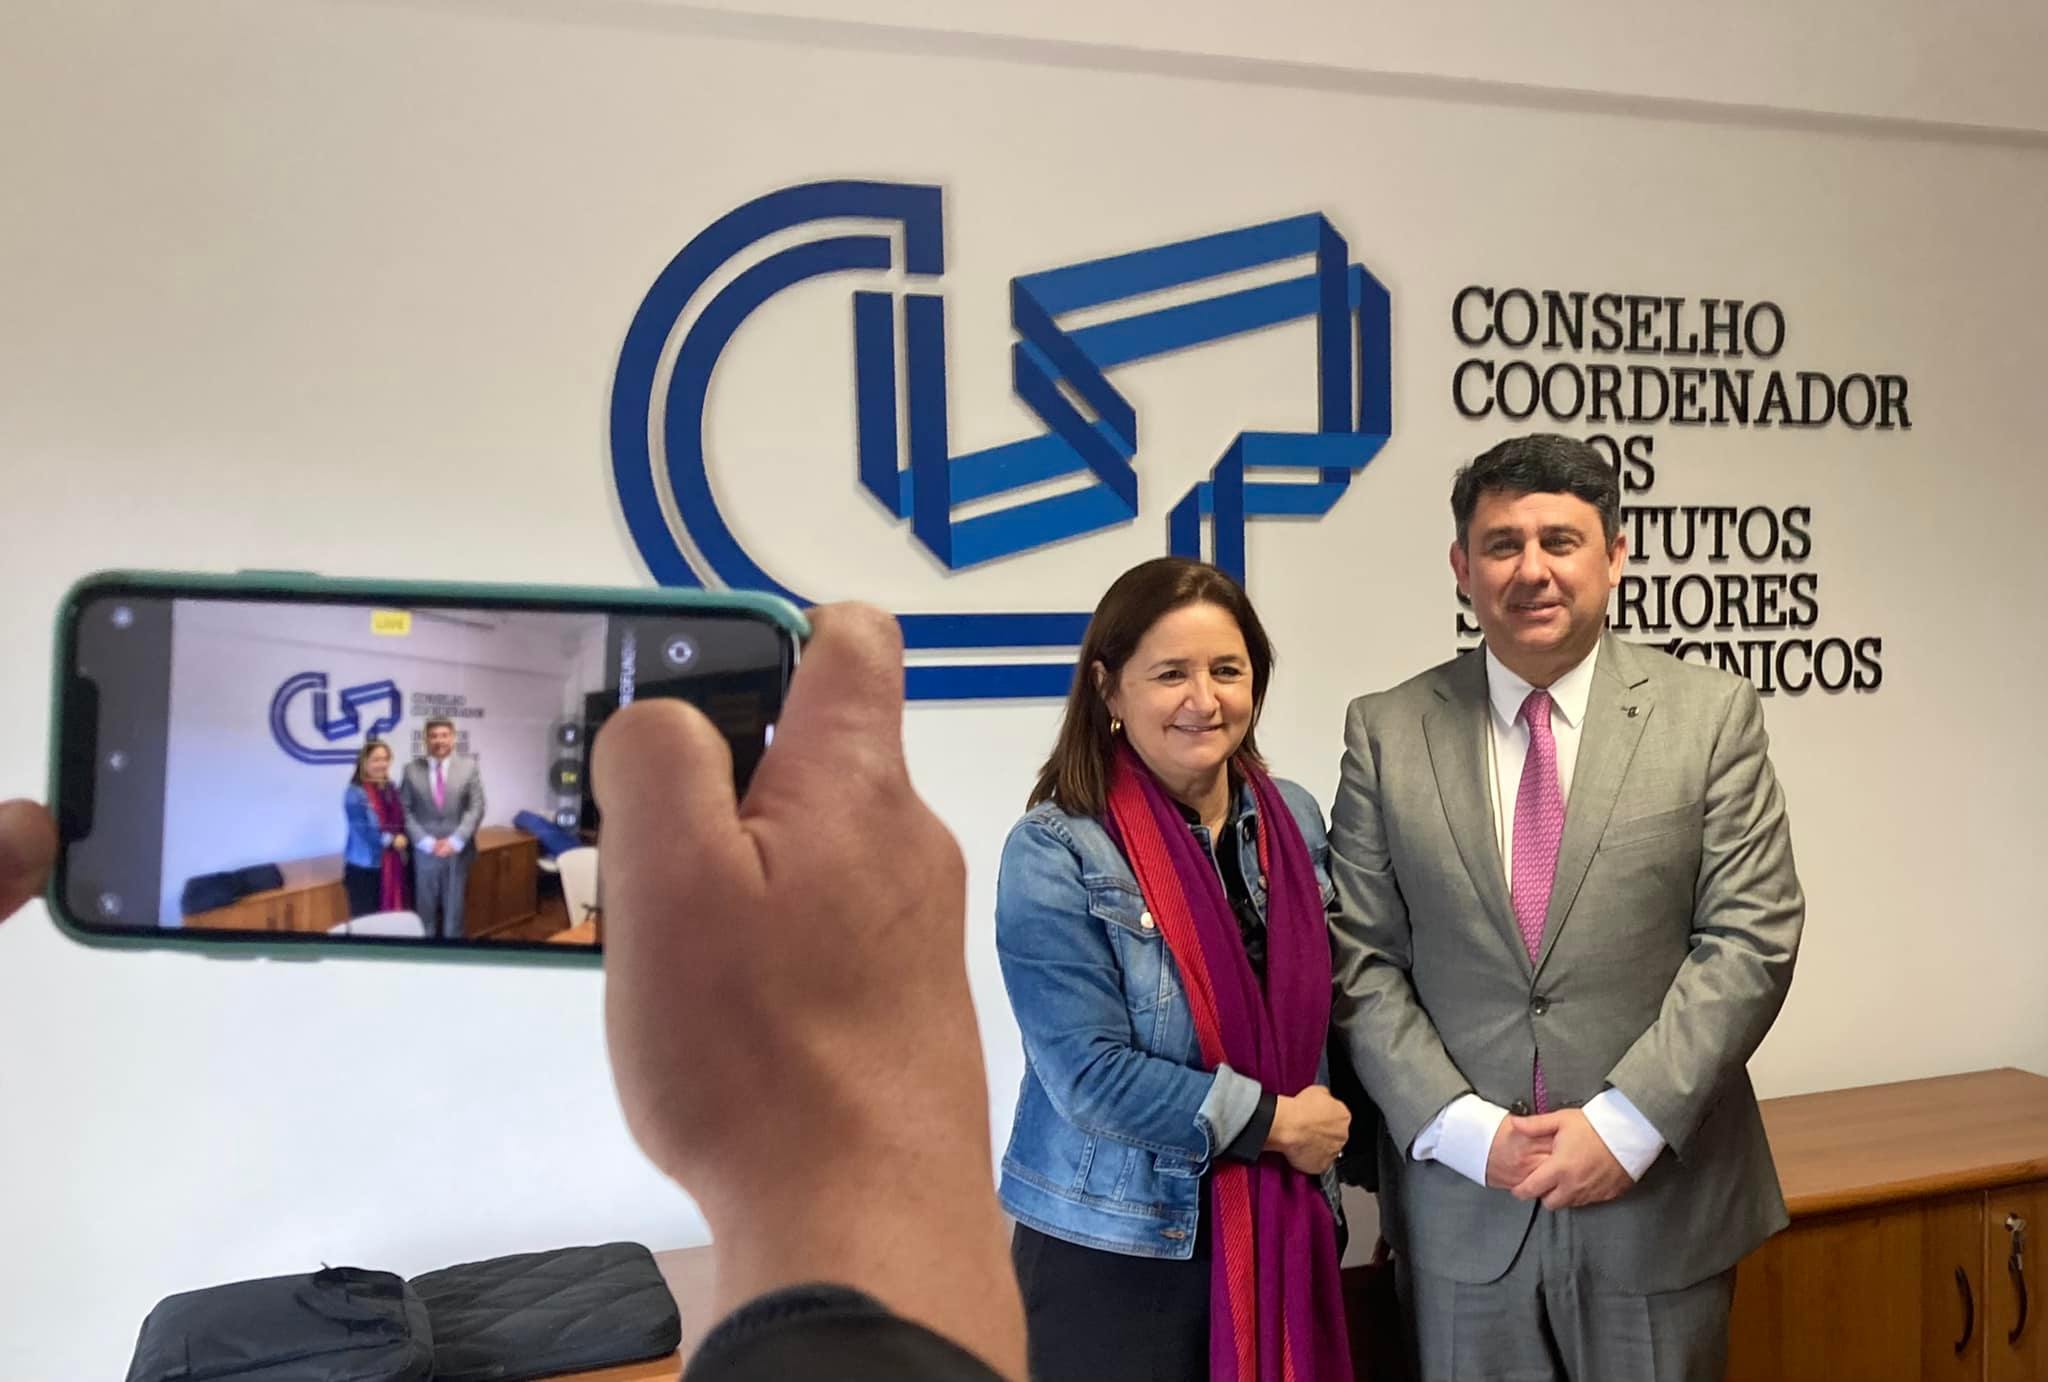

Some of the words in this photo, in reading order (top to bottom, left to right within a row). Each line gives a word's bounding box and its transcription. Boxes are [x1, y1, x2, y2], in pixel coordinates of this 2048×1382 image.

[1452, 286, 1786, 359] CONSELHO
[1452, 359, 1913, 431] COORDENADOR
[1620, 506, 1812, 563] TUTOS
